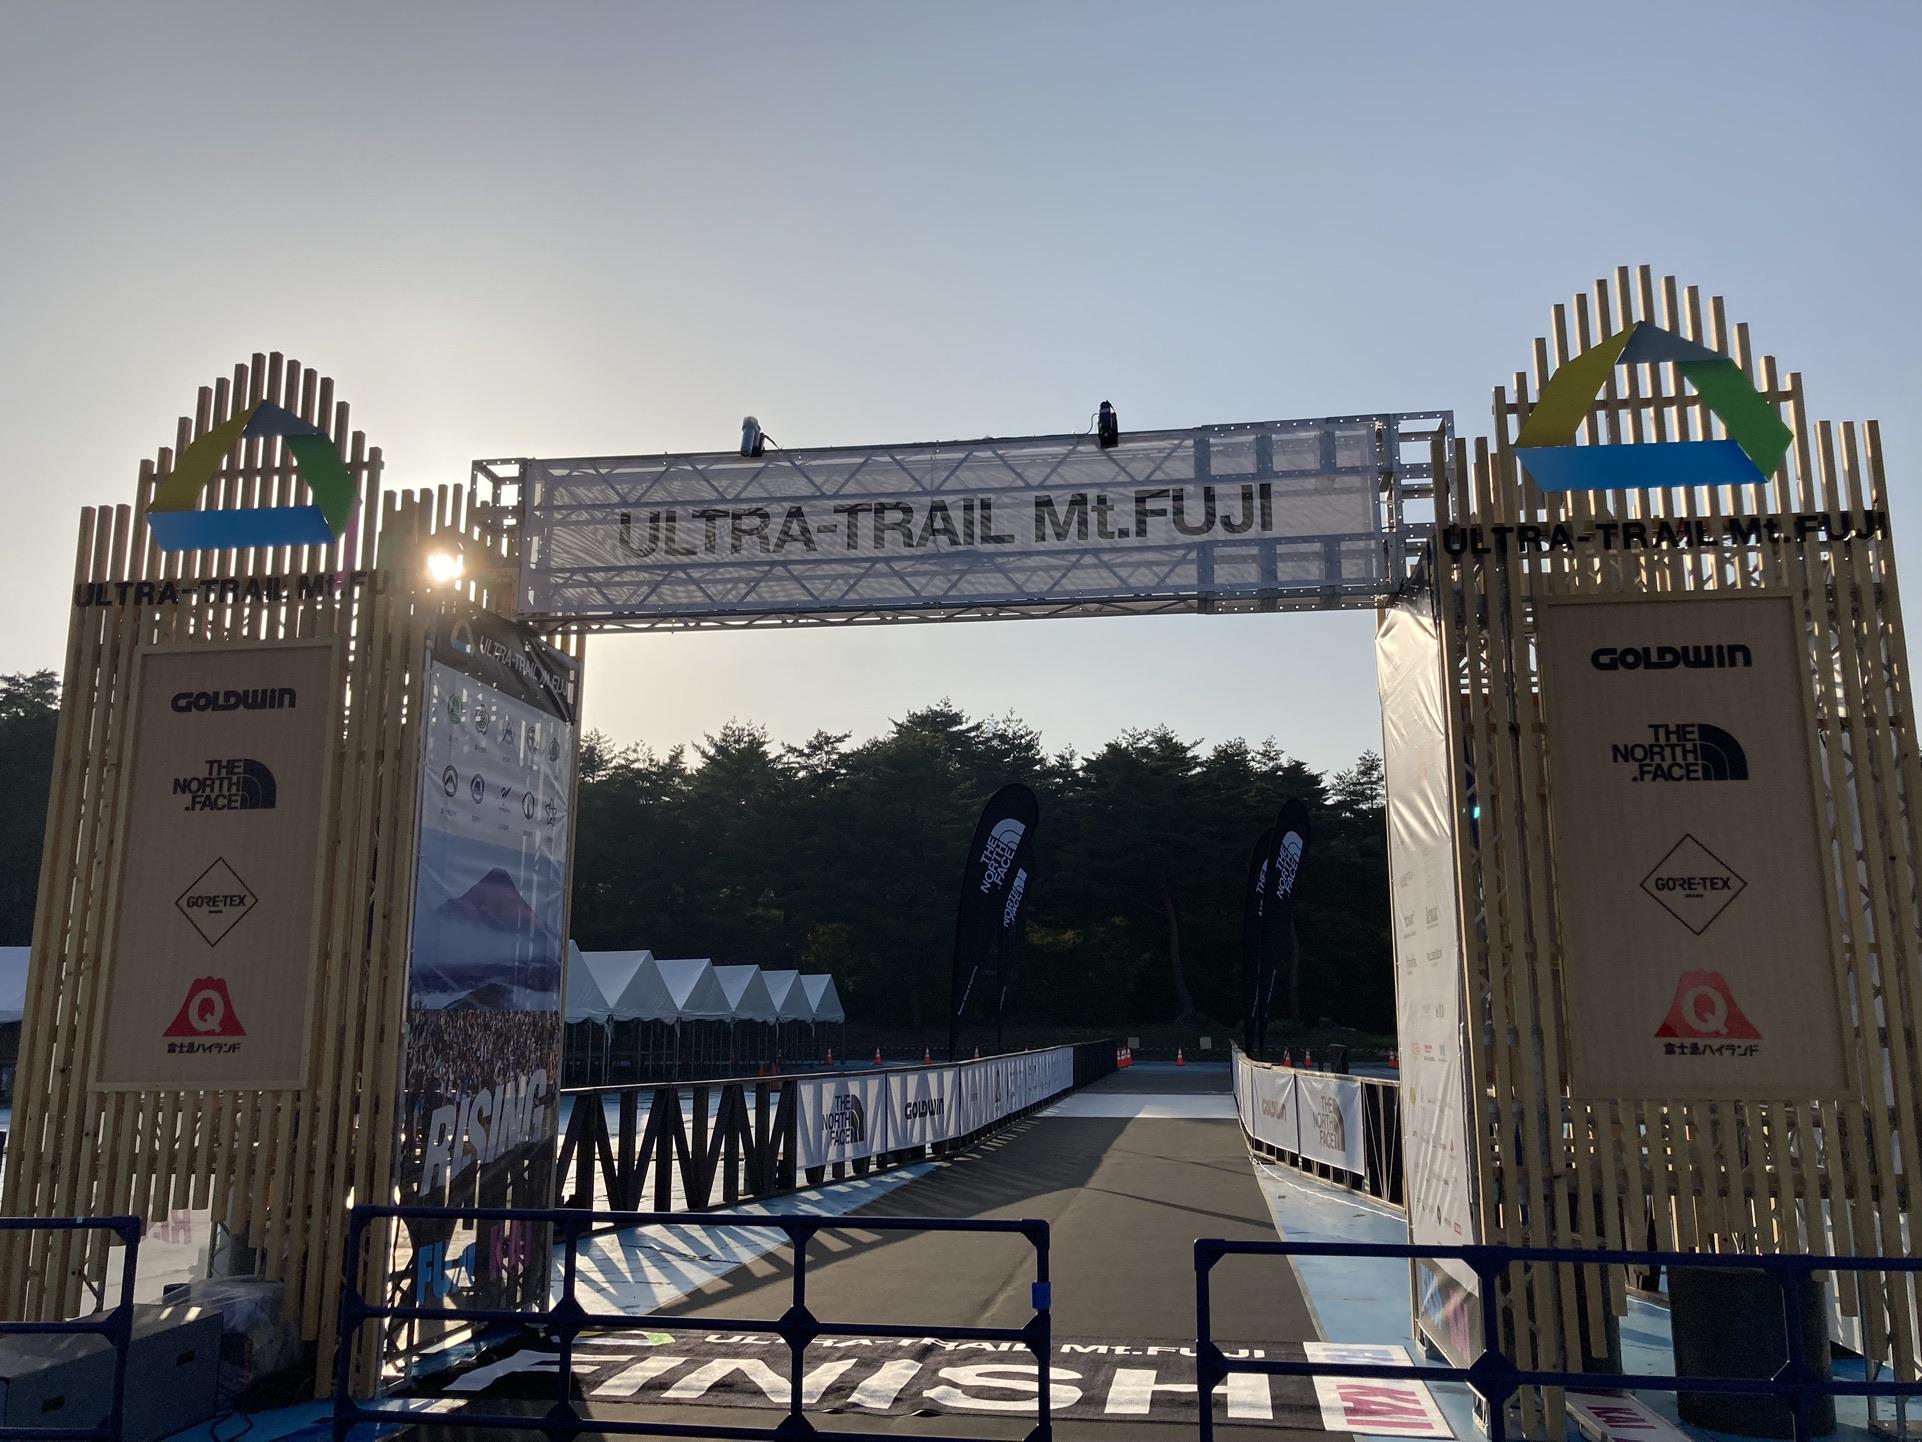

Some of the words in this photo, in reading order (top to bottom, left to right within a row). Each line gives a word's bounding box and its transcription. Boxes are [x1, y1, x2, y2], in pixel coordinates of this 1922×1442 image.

[619, 497, 1014, 559] ULTRA-TRAIL
[1033, 483, 1273, 542] Mt.FUJI
[1443, 518, 1718, 555] ULTRA-TRAIL
[1729, 510, 1889, 544] Mt.FUJI
[75, 575, 286, 608] ULTRA-TRAIL
[1591, 644, 1752, 670] GOLDWIN
[170, 687, 297, 713] GOLDWIN
[1648, 723, 1697, 742] THE
[1612, 743, 1698, 763] NORTH
[205, 759, 243, 776] THE
[172, 776, 241, 795] NORTH
[980, 835, 998, 864] THE
[980, 841, 1007, 894] NORTH
[1655, 876, 1731, 892] GORE-TEX
[186, 894, 247, 909] GORE-TEX
[1664, 1042, 1760, 1057] 富士急ハイランド
[835, 1095, 850, 1110] THE
[822, 1110, 851, 1130] NORTH
[420, 1069, 547, 1197] RISING
[441, 1350, 1273, 1420] FINISH
